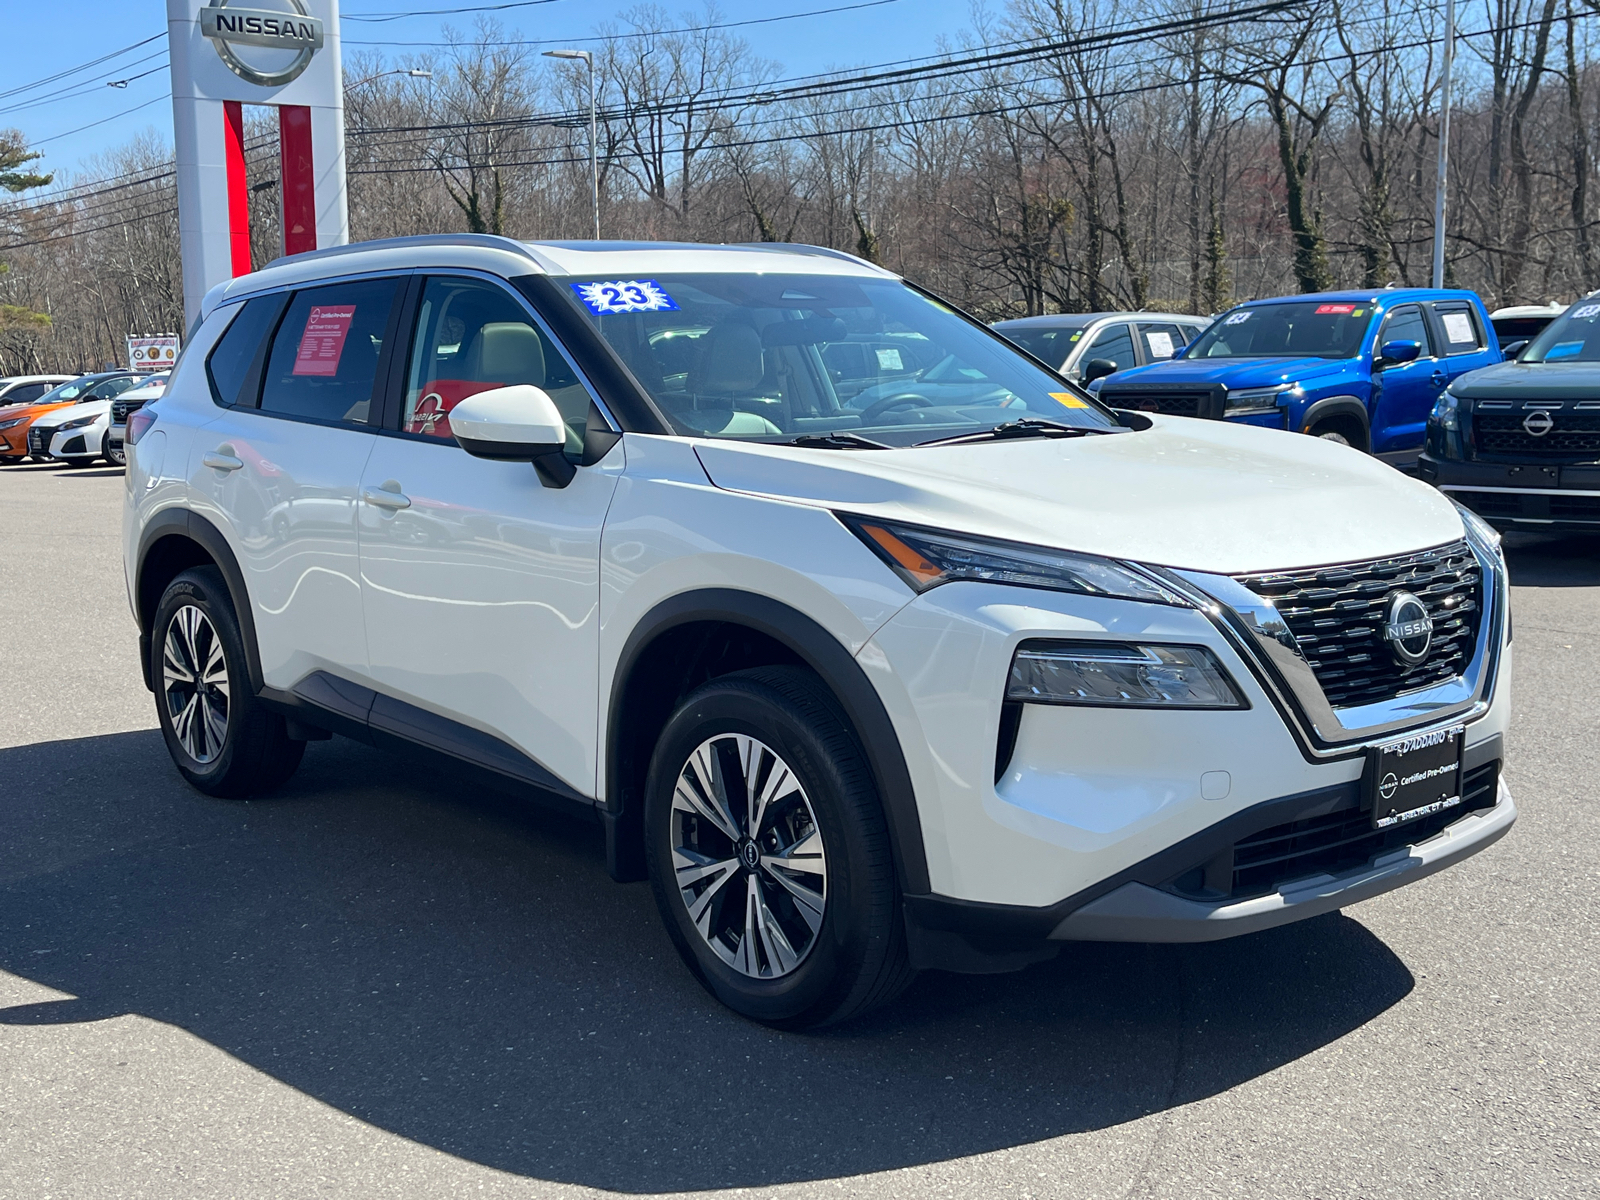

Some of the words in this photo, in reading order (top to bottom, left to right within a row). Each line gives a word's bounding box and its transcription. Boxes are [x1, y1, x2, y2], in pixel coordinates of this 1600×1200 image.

[216, 14, 315, 42] NISSAN
[601, 286, 649, 306] 23
[1388, 620, 1434, 638] NISSAN
[1403, 731, 1446, 754] D'ADDARIO
[1400, 770, 1427, 786] Certified
[1427, 760, 1459, 779] Pre-Owned
